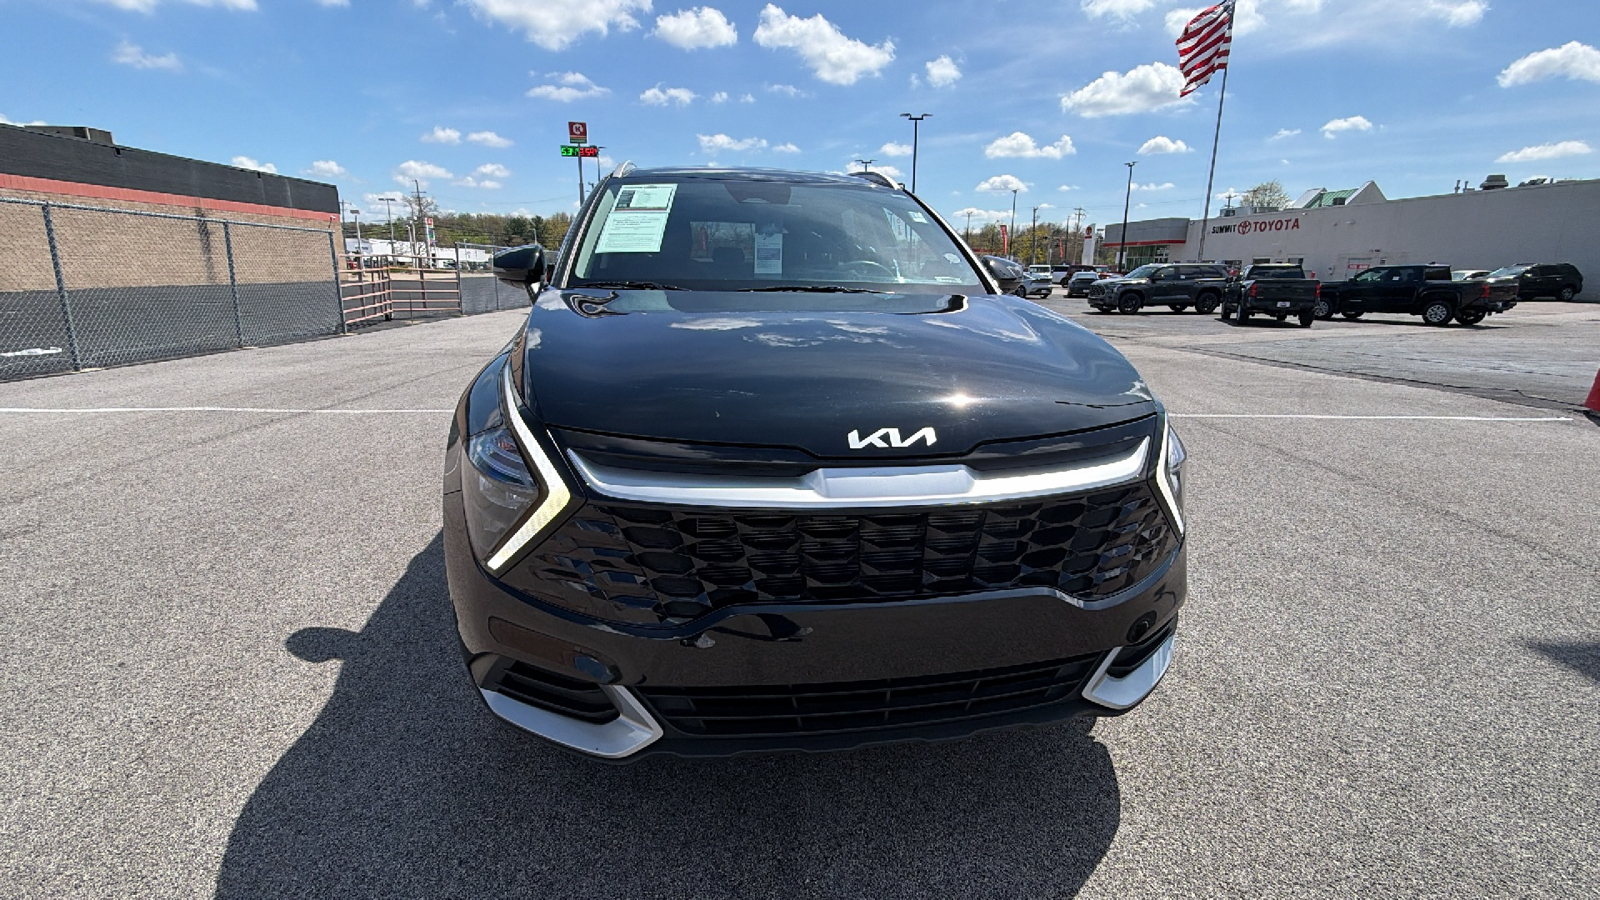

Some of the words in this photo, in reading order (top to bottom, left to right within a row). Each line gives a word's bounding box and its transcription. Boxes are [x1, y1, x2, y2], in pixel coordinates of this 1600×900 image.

[1212, 224, 1237, 233] SUMMIT
[1253, 218, 1300, 232] TOYOTA
[847, 427, 937, 449] KIA
